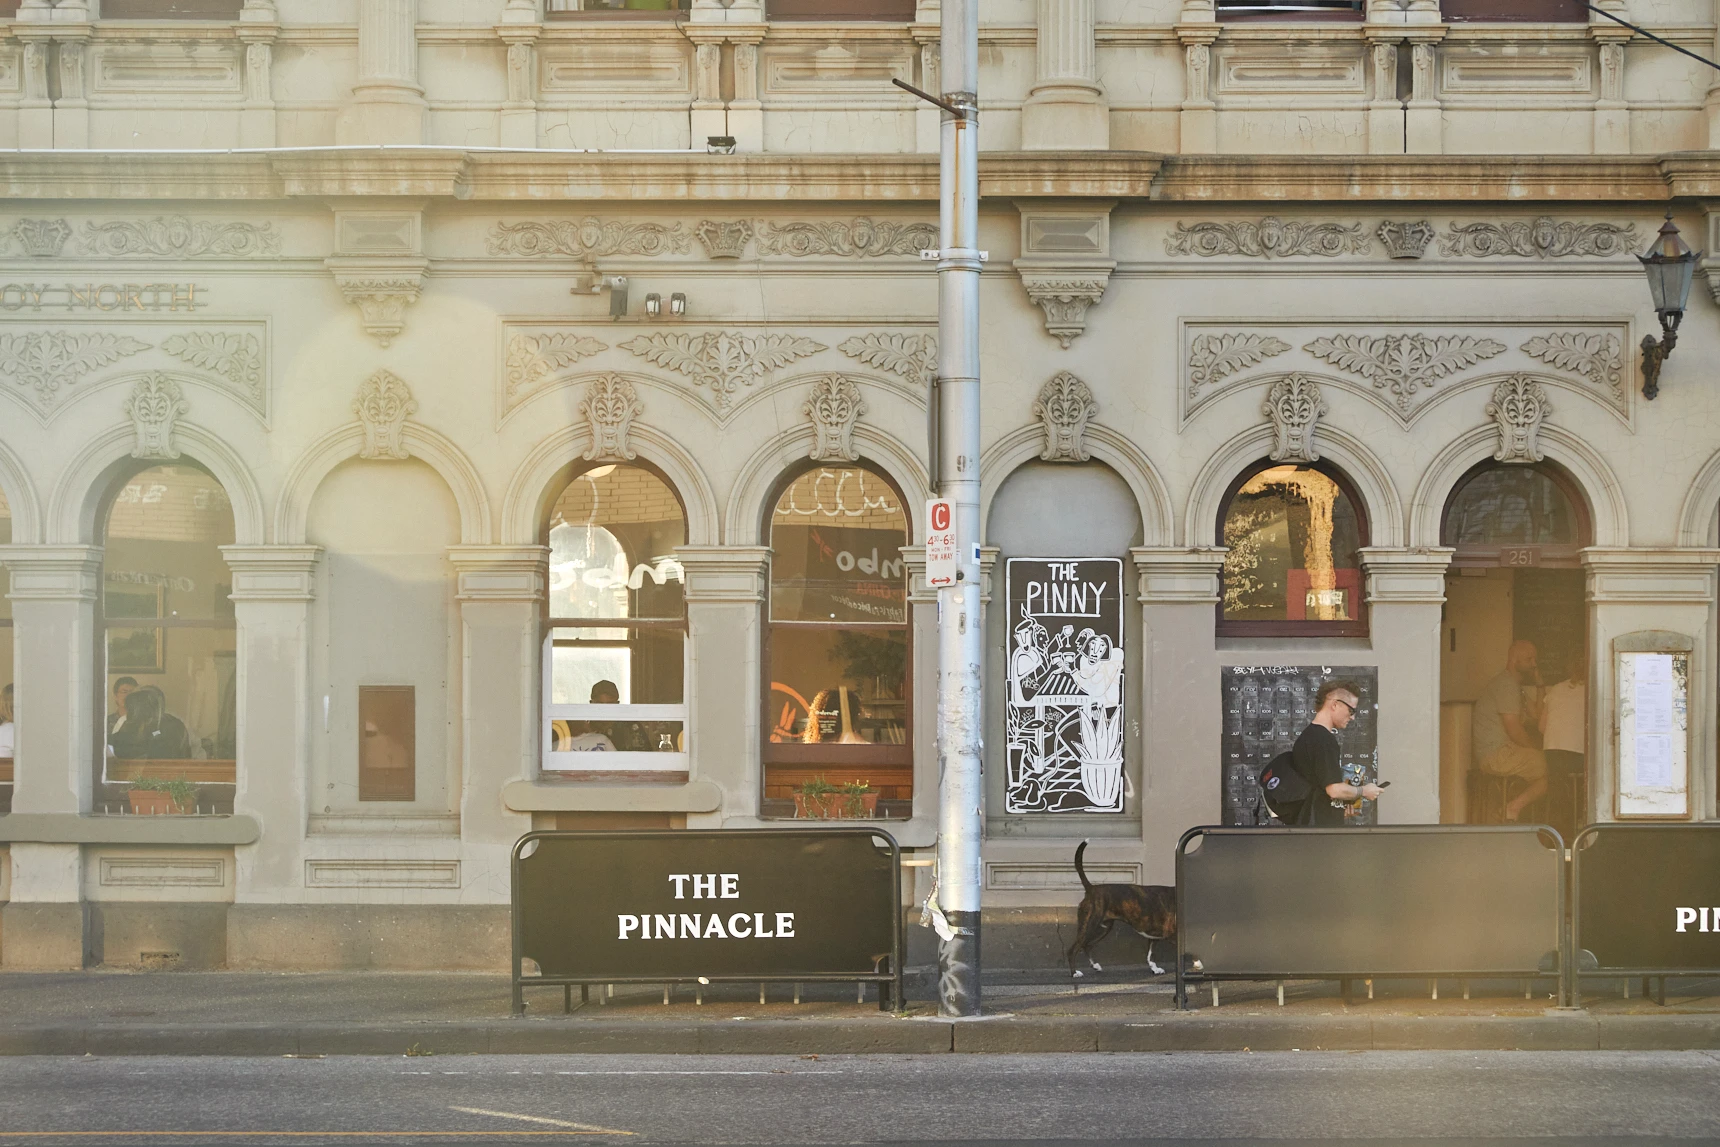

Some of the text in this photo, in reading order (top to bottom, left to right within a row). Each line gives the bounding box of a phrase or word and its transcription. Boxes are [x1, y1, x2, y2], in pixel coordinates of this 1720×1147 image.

[65, 283, 196, 311] NORTH
[935, 505, 947, 528] C
[929, 553, 953, 562] TOW AWAY
[1509, 551, 1533, 565] 251
[1048, 562, 1079, 582] THE
[1026, 581, 1107, 613] PINNY
[668, 873, 740, 900] THE
[617, 912, 796, 940] PINNACLE
